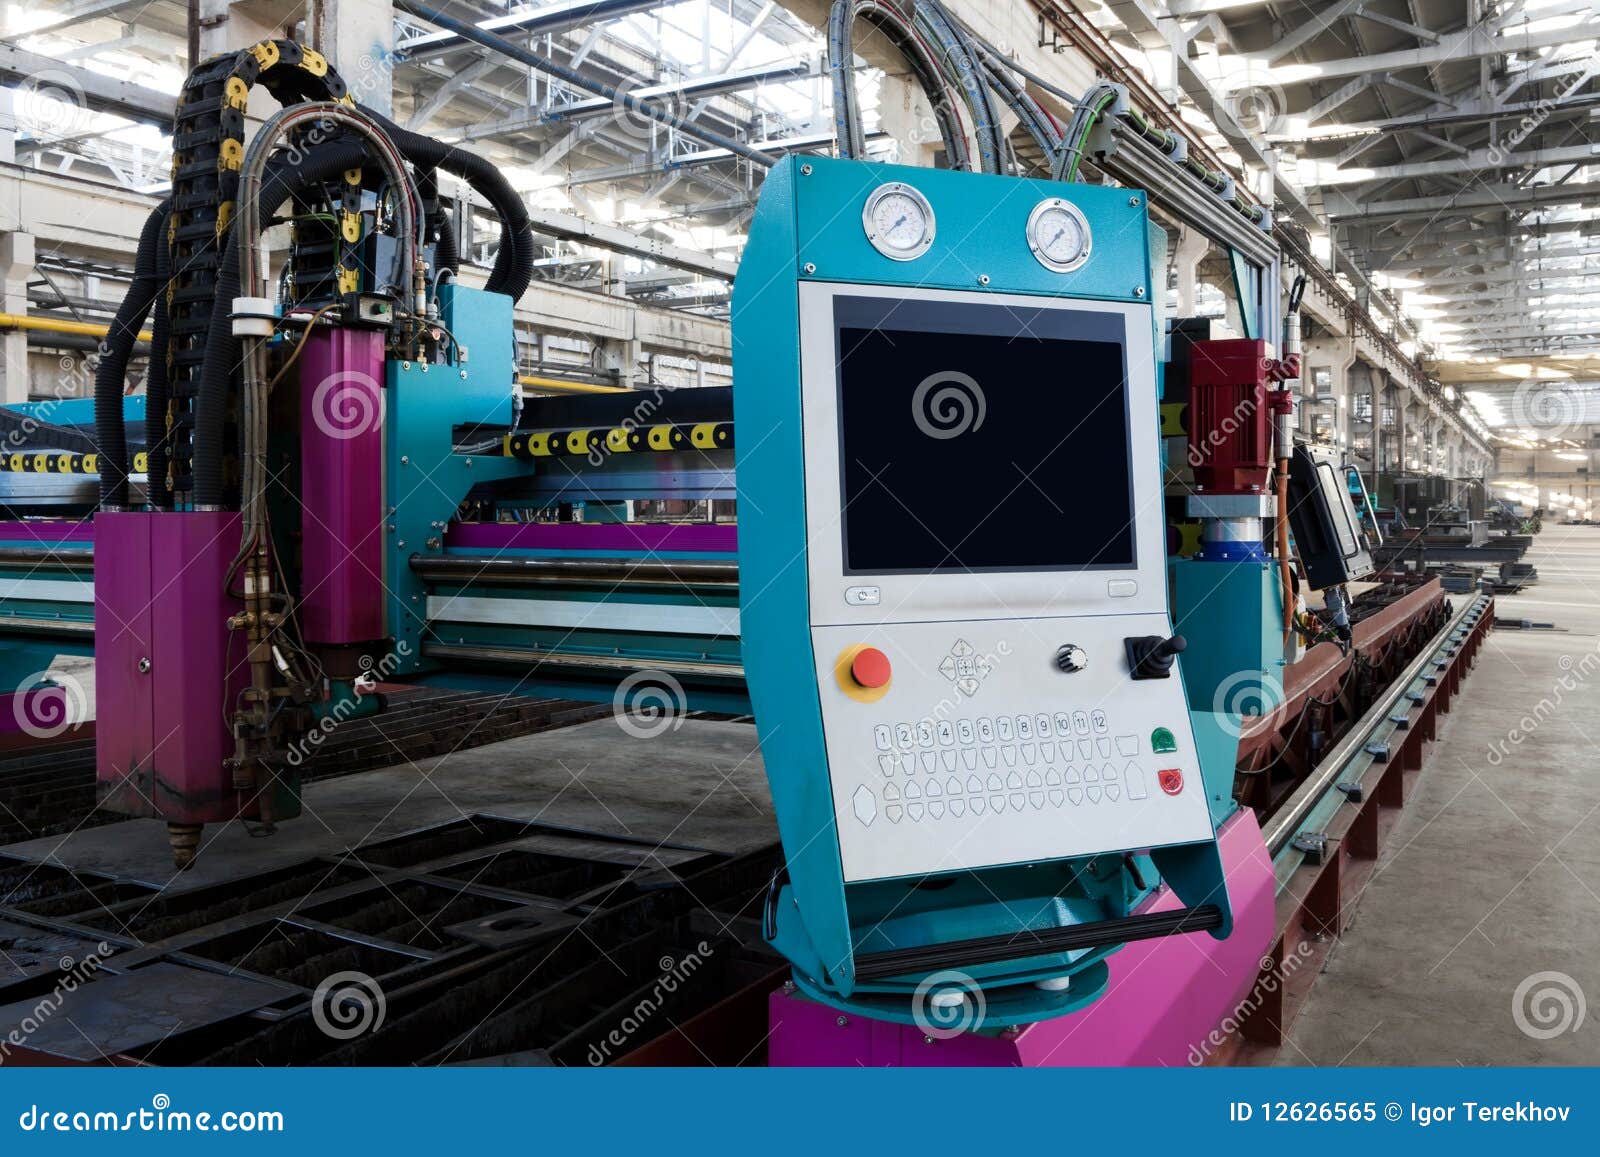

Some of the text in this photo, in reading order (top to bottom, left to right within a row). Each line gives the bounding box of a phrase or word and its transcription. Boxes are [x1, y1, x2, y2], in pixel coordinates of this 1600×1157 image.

[901, 730, 909, 741] 2
[922, 729, 929, 740] 3
[942, 727, 949, 738] 4
[962, 726, 970, 737] 5
[982, 725, 990, 736] 6
[1001, 723, 1008, 734] 7
[1021, 722, 1029, 732] 8
[1040, 720, 1048, 731] 9
[1057, 719, 1068, 730] 10
[1077, 718, 1086, 728] 11
[1095, 716, 1105, 727] 12
